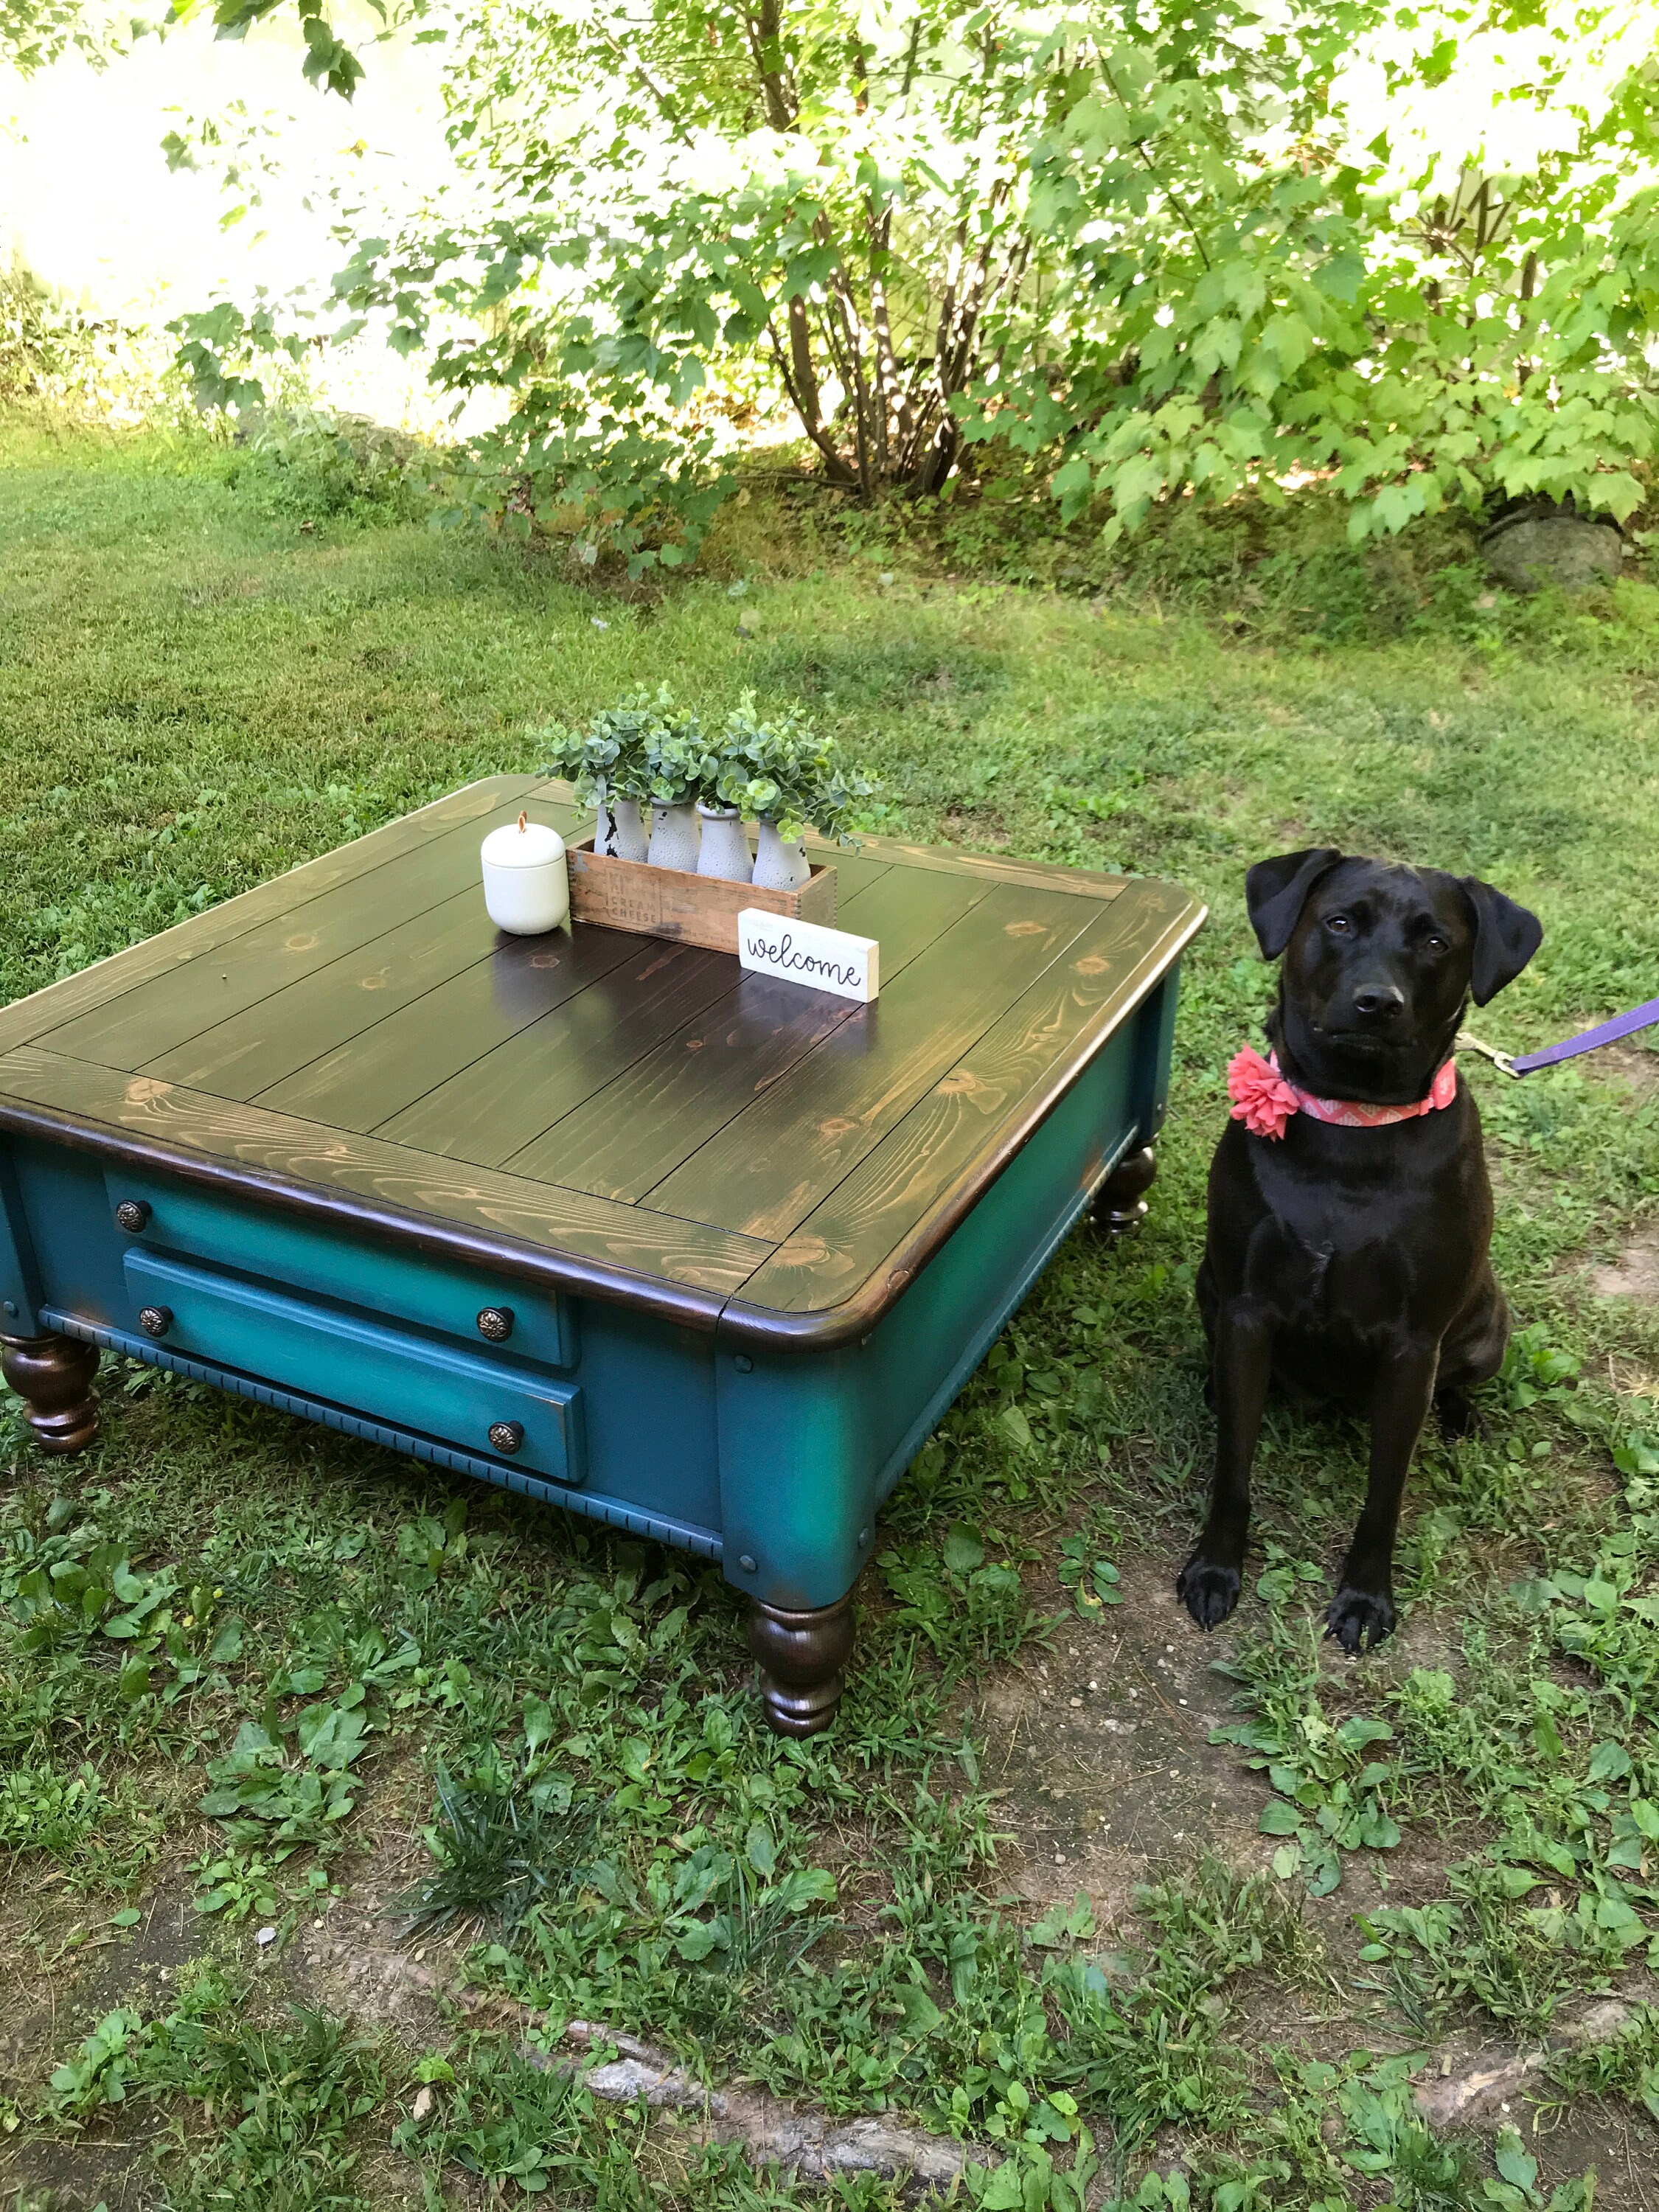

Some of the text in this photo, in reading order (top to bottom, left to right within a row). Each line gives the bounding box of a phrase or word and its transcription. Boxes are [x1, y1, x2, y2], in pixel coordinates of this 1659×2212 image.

[611, 896, 655, 912] CREAM
[611, 908, 656, 923] CHEESE
[747, 933, 861, 987] welcome
